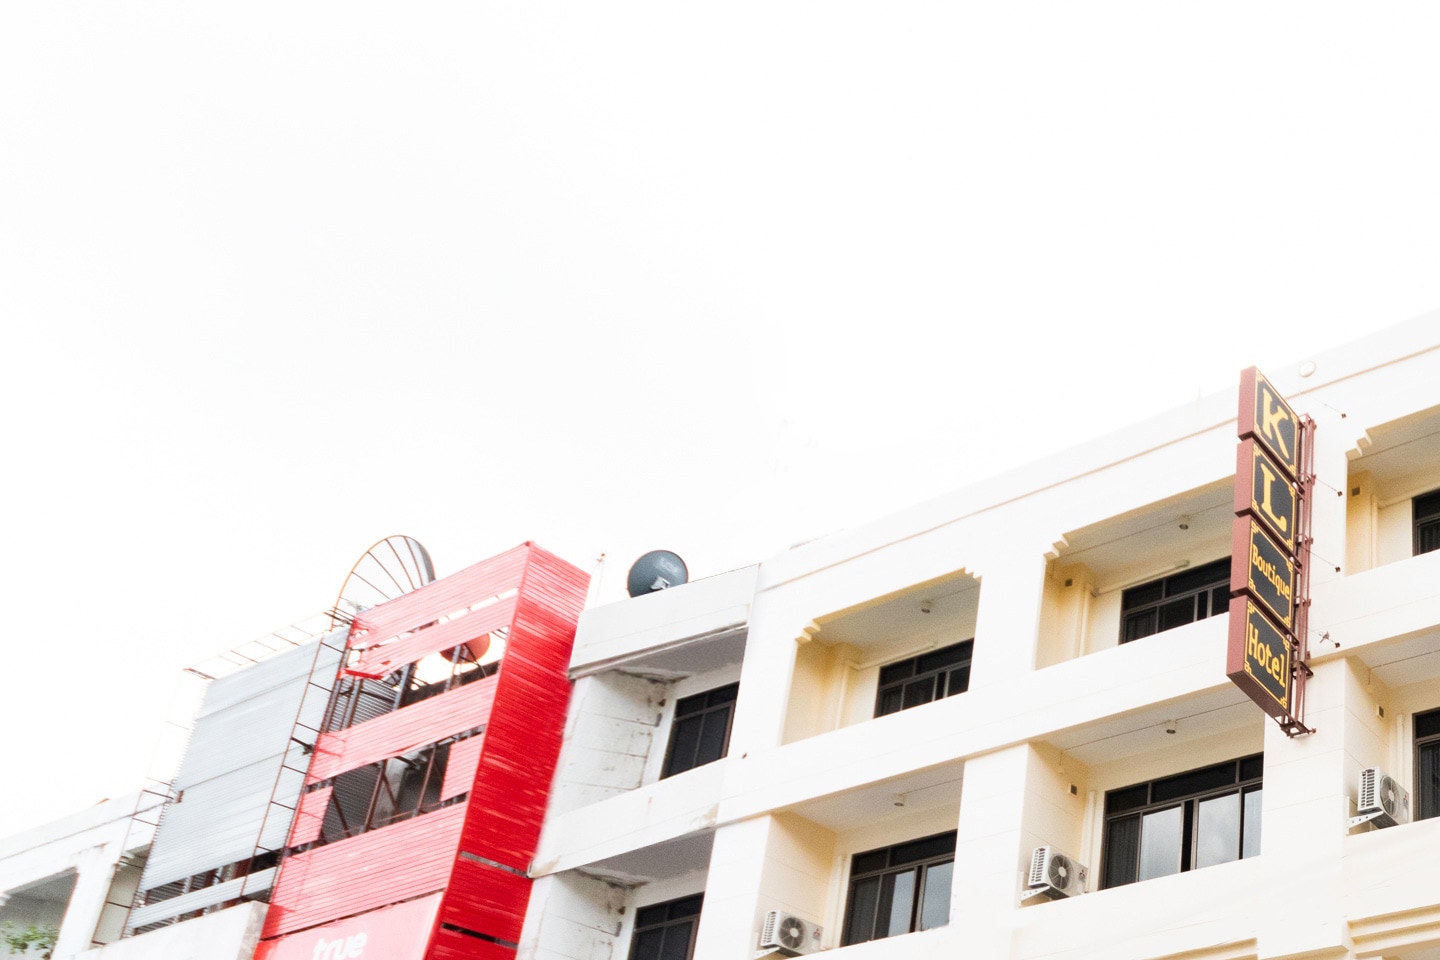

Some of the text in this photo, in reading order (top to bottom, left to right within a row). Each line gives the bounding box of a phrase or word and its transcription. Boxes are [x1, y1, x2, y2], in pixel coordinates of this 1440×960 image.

[1262, 387, 1289, 459] K
[1260, 463, 1287, 532] L
[1251, 544, 1290, 599] Boutique
[1248, 622, 1286, 688] Hotel
